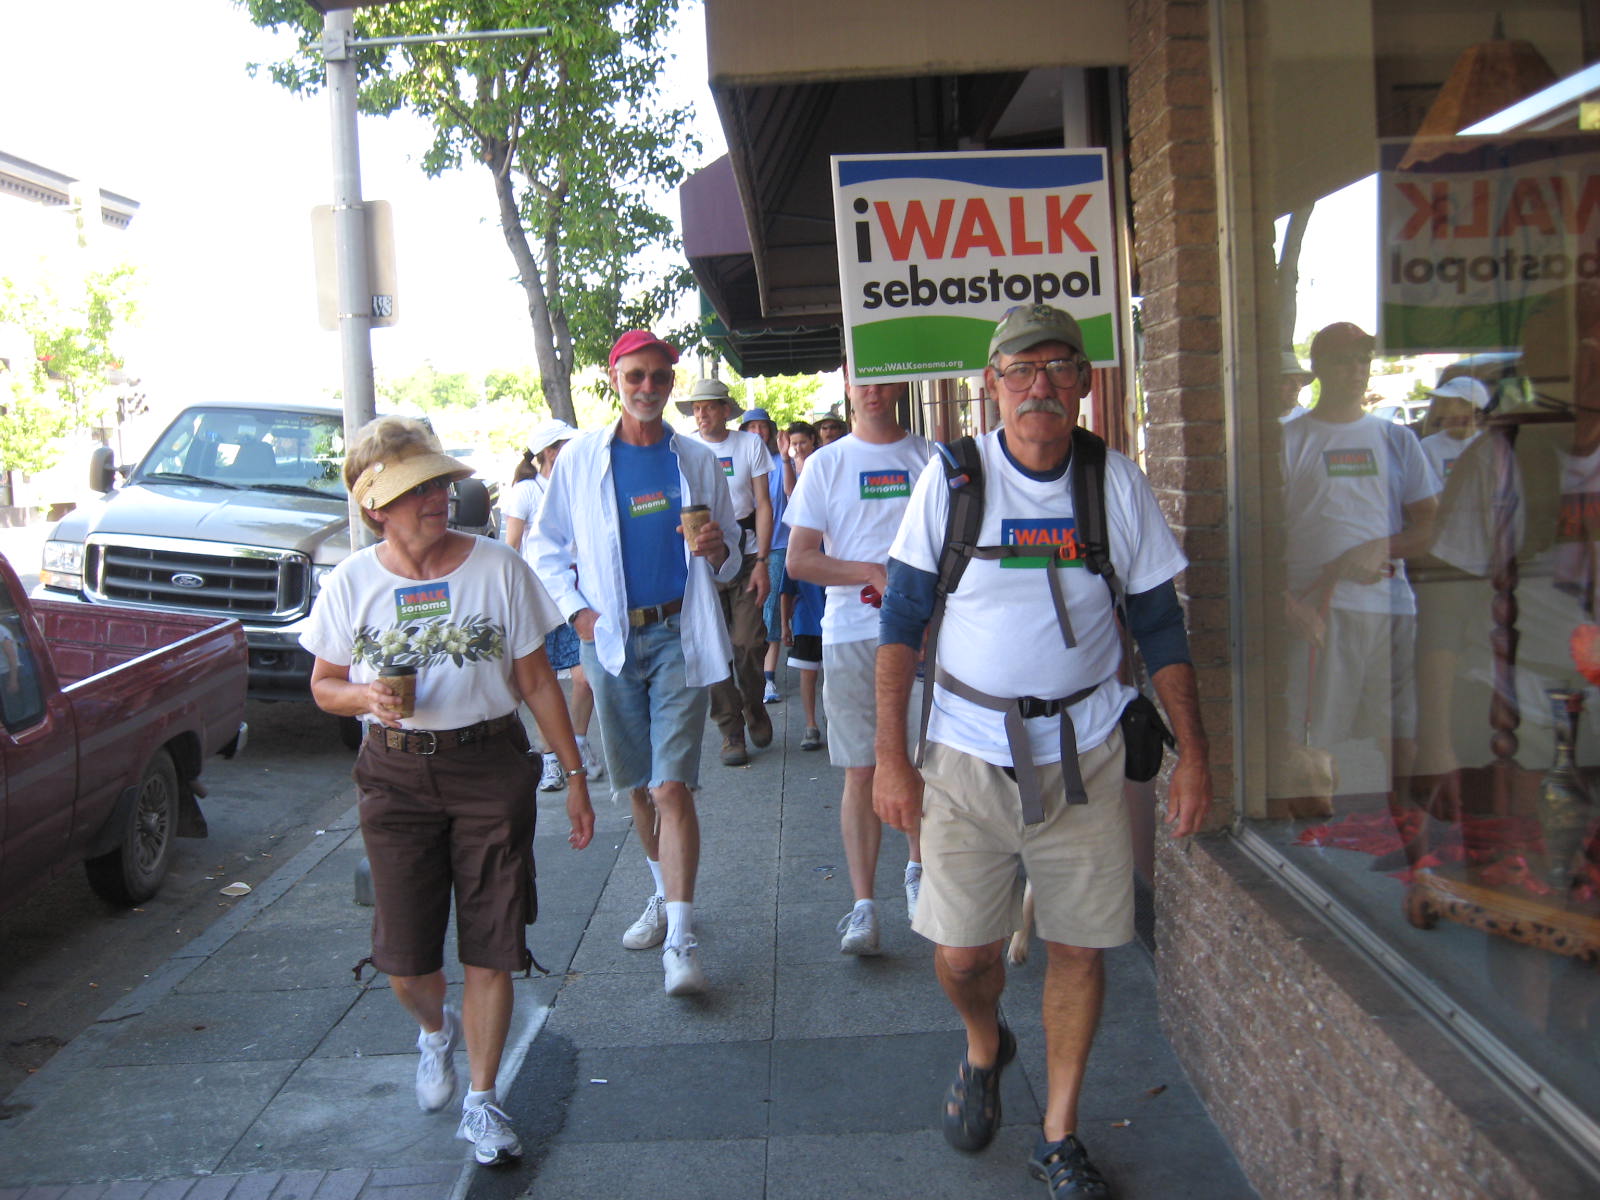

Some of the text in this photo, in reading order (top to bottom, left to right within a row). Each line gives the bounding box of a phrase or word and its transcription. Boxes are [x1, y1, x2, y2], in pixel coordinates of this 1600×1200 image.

[853, 194, 1098, 262] iWALK
[863, 255, 1101, 309] sebastopol
[857, 360, 963, 374] www.iWALKsonoma.org
[1008, 528, 1076, 545] iWALK
[400, 589, 447, 605] iWALK
[401, 600, 447, 614] sonoma
